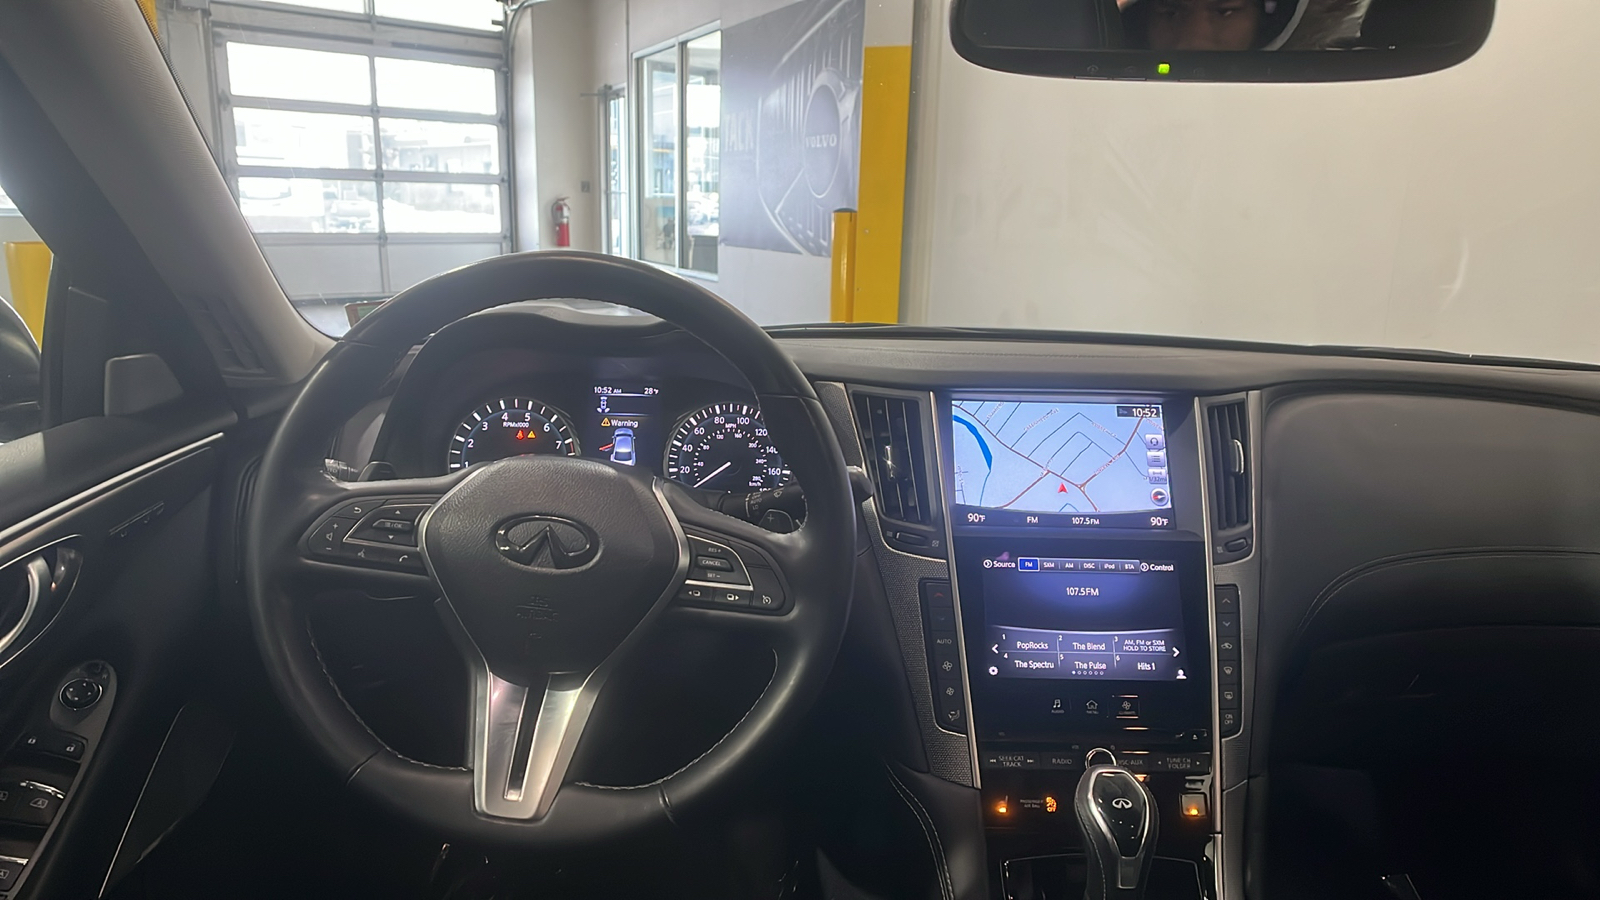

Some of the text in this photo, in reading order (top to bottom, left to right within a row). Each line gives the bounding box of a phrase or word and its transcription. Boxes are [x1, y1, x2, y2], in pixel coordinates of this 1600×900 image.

[806, 134, 837, 148] VOLVO
[594, 386, 612, 394] 10:52
[502, 412, 508, 421] 4
[524, 412, 531, 421] 5
[1132, 408, 1157, 418] 10:52
[611, 419, 639, 428] Warning
[714, 416, 725, 425] 80
[736, 416, 750, 425] 100
[482, 422, 489, 431] 3
[543, 423, 550, 432] 6
[694, 427, 705, 435] 60
[755, 428, 768, 437] 120
[467, 438, 474, 448] 2
[555, 440, 562, 450] 7
[682, 443, 693, 452] 40
[680, 465, 690, 474] 20
[767, 467, 781, 476] 160
[1026, 516, 1039, 524] FM
[993, 560, 1016, 569] Source
[1150, 563, 1174, 572] Control
[1016, 641, 1049, 650] PopRocks
[1073, 642, 1106, 651] The Blend
[1014, 660, 1055, 670] The Spectru
[1074, 661, 1107, 670] The Pulse
[1137, 662, 1151, 670] Hits
